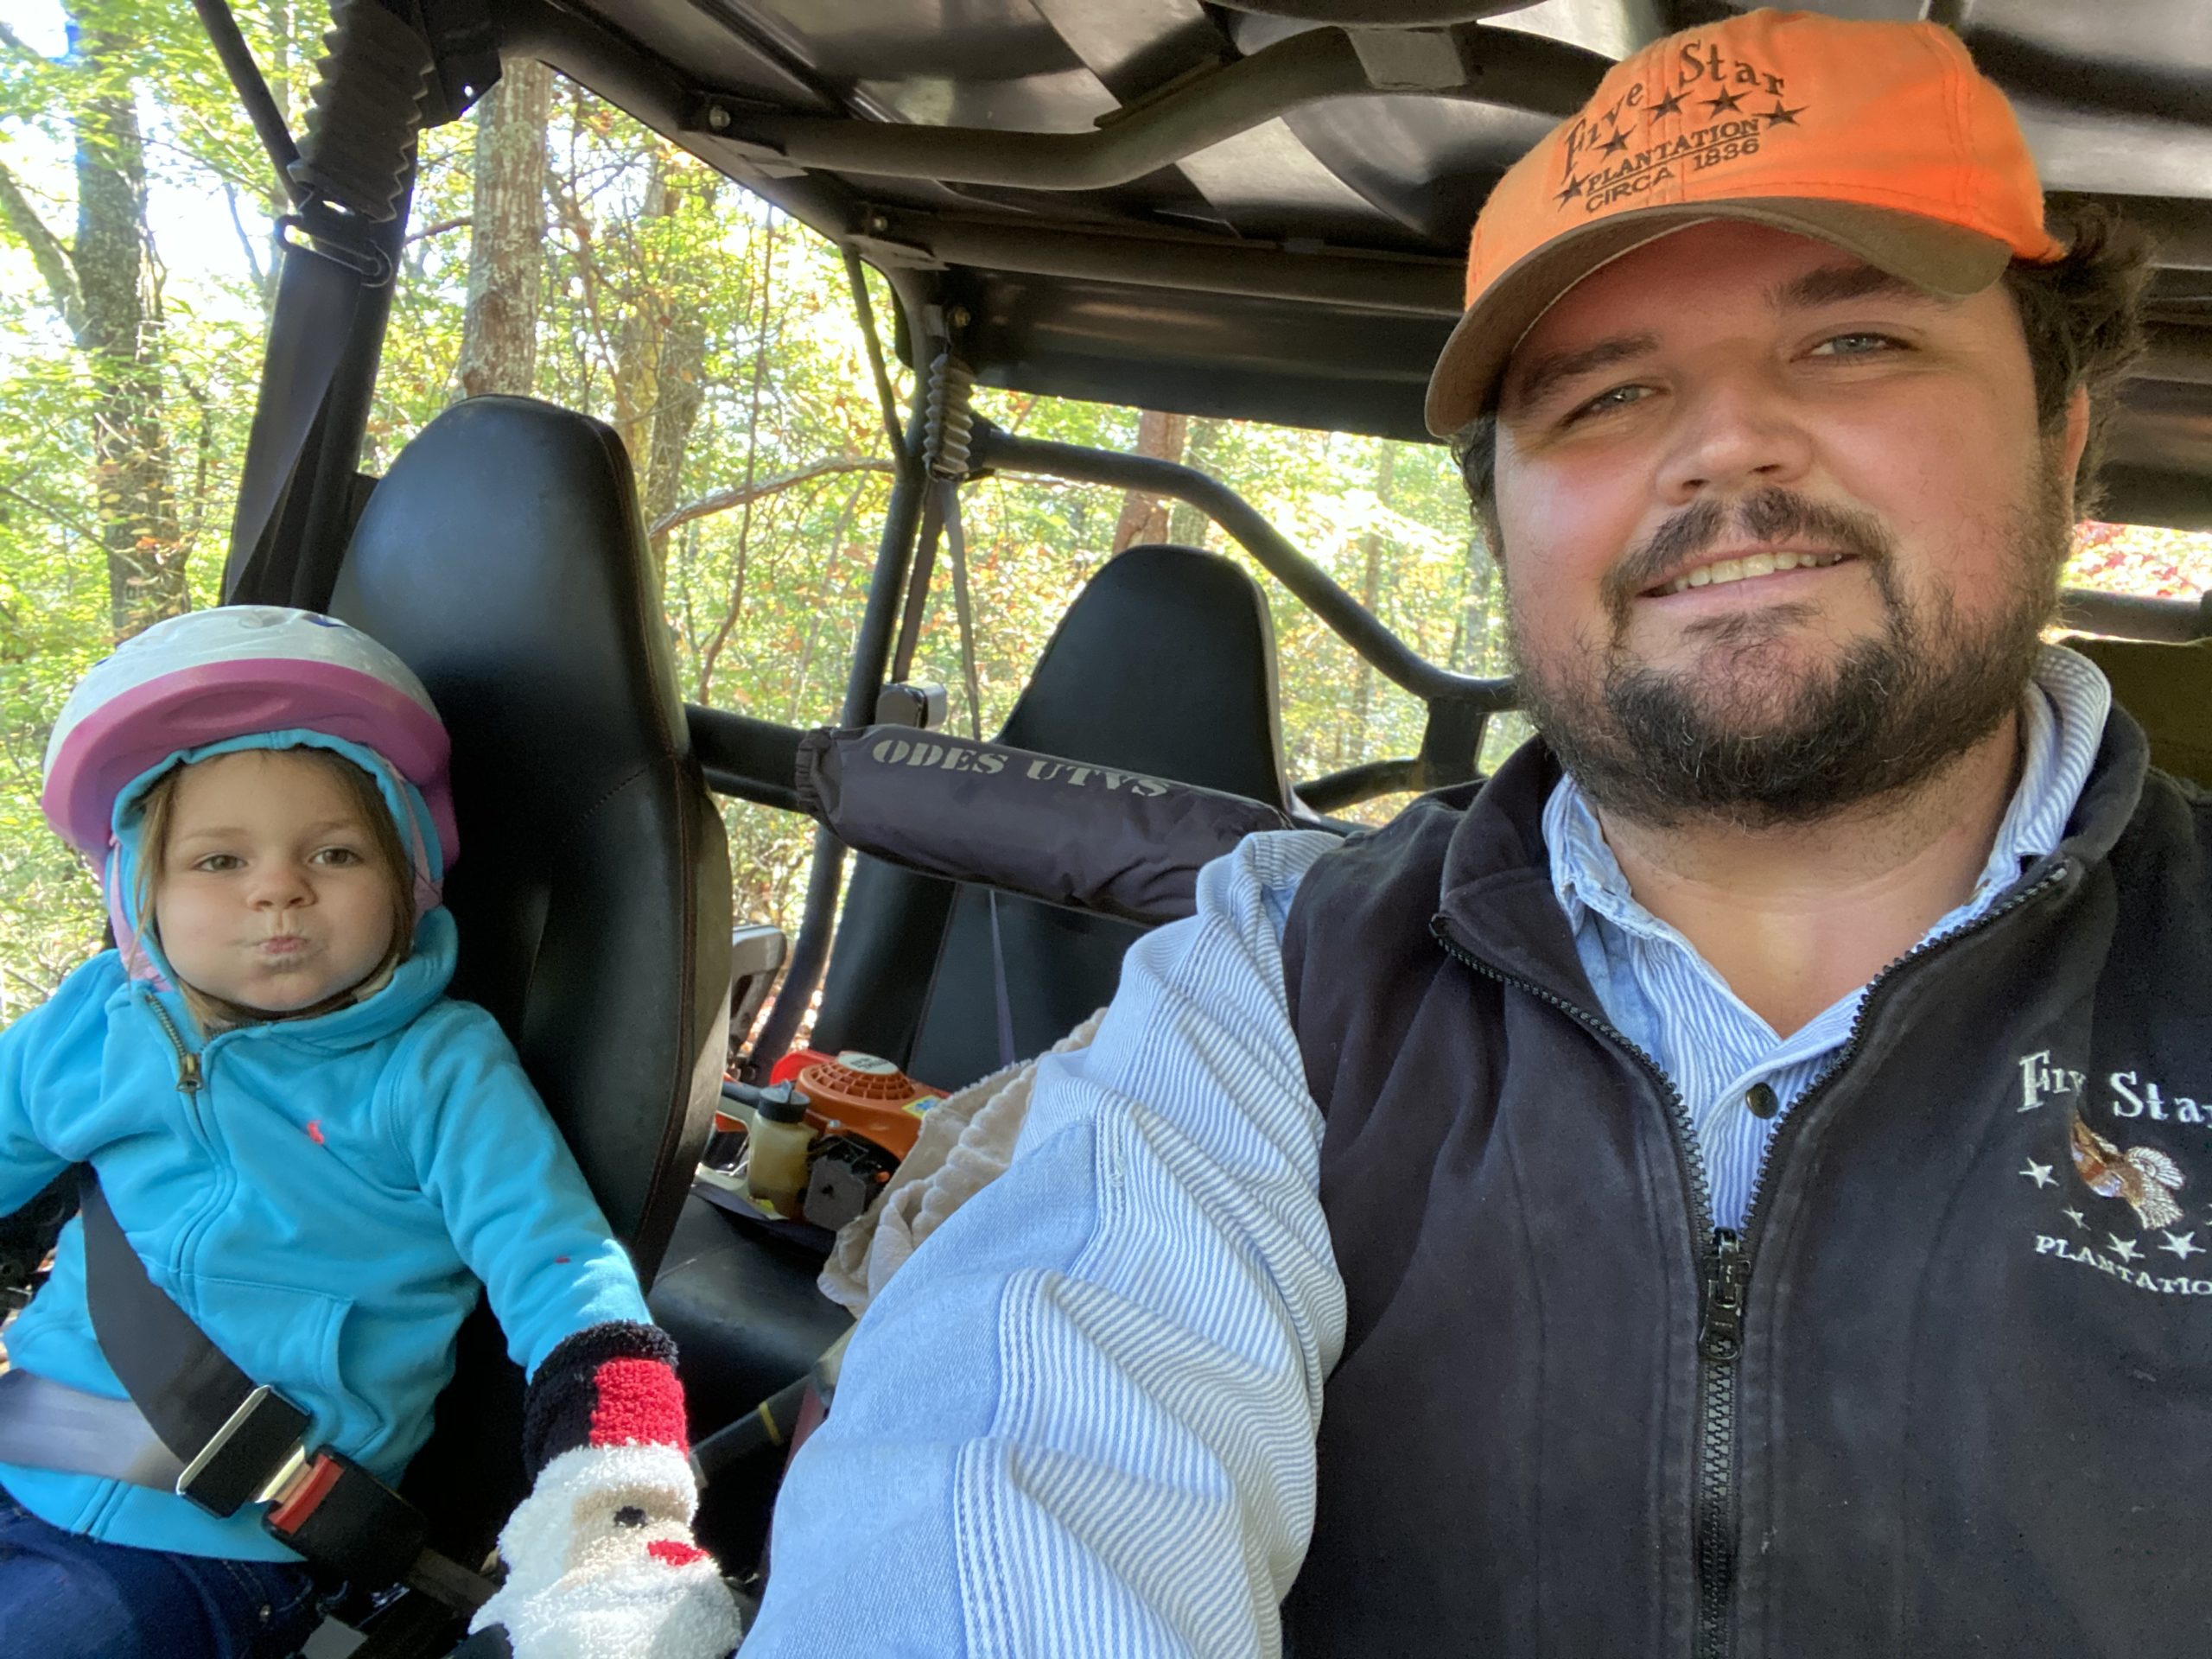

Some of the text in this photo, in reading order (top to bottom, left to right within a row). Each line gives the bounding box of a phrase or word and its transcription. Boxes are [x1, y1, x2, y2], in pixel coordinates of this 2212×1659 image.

[1561, 40, 1784, 185] Five Star
[1587, 118, 1759, 192] PLANTATION
[1586, 168, 1675, 213] CIRCA
[872, 739, 1170, 797] ODES UTVS
[2017, 1050, 2087, 1113] Fiv
[2035, 1235, 2212, 1295] PLANTATIO
